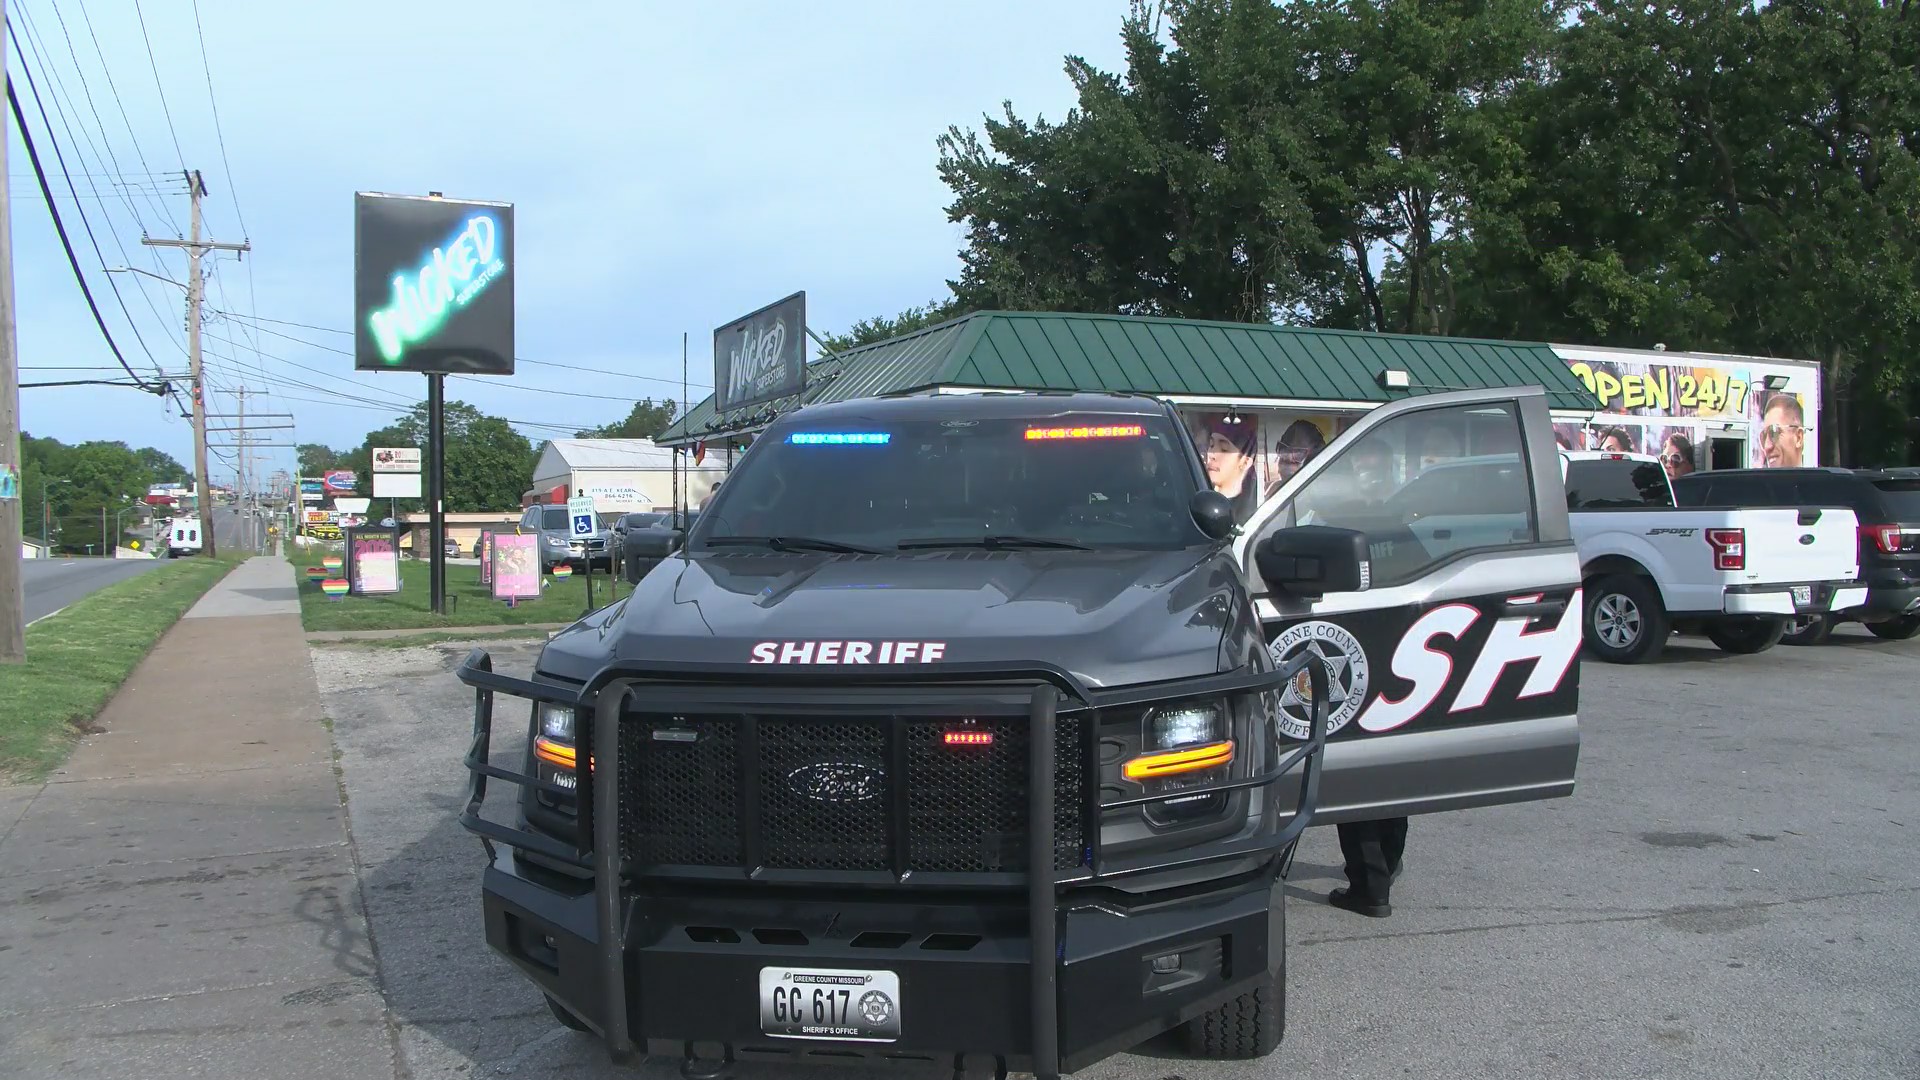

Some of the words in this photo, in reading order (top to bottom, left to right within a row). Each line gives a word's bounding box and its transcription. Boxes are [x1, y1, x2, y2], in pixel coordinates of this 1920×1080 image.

[371, 215, 495, 358] WICKED
[456, 257, 505, 305] SUPERSTORE
[727, 321, 786, 399] WICKED
[756, 363, 786, 391] SUPERSTORE
[1570, 362, 1670, 410] OPEN
[1679, 374, 1749, 413] 24/7
[570, 499, 592, 508] RESERVED
[1645, 528, 1699, 536] SPORT
[749, 641, 946, 664] SHERIFF
[1316, 624, 1365, 666] COUNTY
[1357, 587, 1584, 733] SH
[1326, 687, 1365, 731] OFFICE
[794, 975, 816, 983] GREENE
[816, 976, 838, 984] COUNTY
[838, 977, 864, 985] MISSOURI
[773, 986, 802, 1023] GC
[812, 988, 850, 1025] 617
[802, 1026, 835, 1034] SHERIFF'S
[835, 1027, 858, 1035] OFFICE
